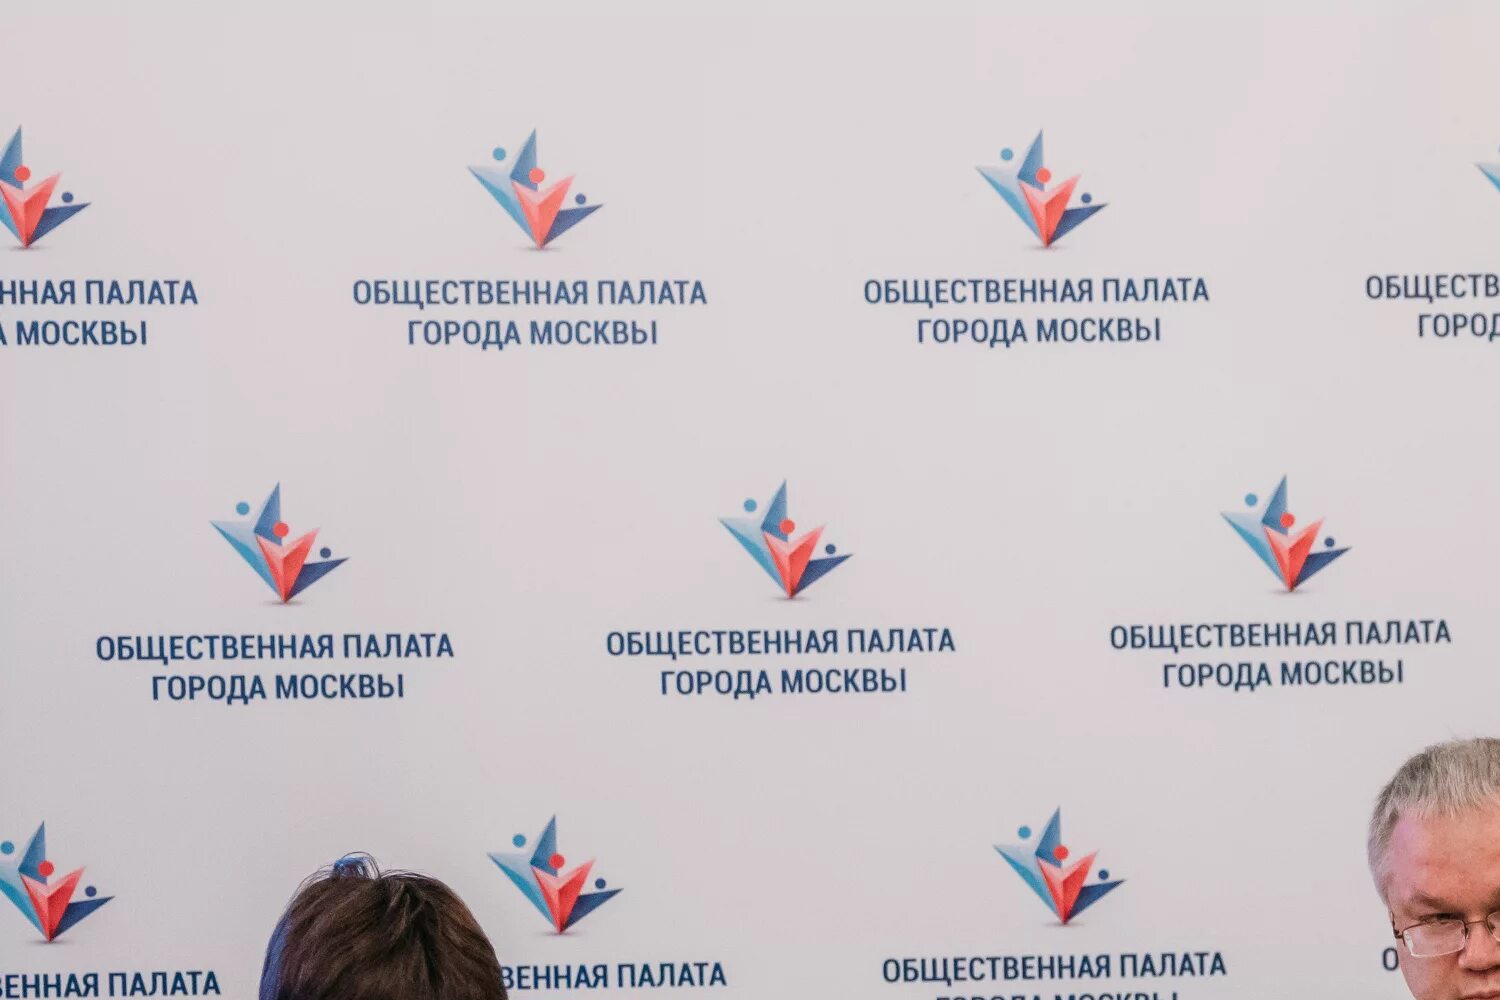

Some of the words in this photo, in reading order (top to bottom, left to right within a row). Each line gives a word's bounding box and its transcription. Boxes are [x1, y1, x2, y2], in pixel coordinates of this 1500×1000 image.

[85, 279, 198, 305] ПАЛАТА
[353, 279, 588, 311] ОБЩЕСТВЕННАЯ
[597, 280, 708, 305] ПАЛАТА
[864, 278, 1093, 309] ОБЩЕСТВЕННАЯ
[1102, 277, 1210, 303] ПАЛАТА
[16, 320, 147, 346] МОСКВЫ
[408, 320, 522, 351] ГОРОДА
[530, 320, 657, 345] МОСКВЫ
[918, 318, 1028, 349] ГОРОДА
[1036, 317, 1161, 343] МОСКВЫ
[96, 634, 334, 666] ОБЩЕСТВЕННАЯ
[343, 633, 454, 659] ПАЛАТА
[606, 629, 838, 661] ОБЩЕСТВЕННАЯ
[847, 628, 956, 653] ПАЛАТА
[1110, 621, 1337, 654] ОБЩЕСТВЕННАЯ
[1345, 619, 1452, 645] ПАЛАТА
[152, 674, 267, 706] ГОРОДА
[275, 673, 404, 700] МОСКВЫ
[661, 669, 772, 700] ГОРОДА
[781, 668, 906, 694] МОСКВЫ
[1163, 662, 1273, 692] ГОРОДА
[1280, 659, 1403, 686] МОСКВЫ
[108, 970, 221, 997] ПАЛАТА
[617, 962, 727, 988] ПАЛАТА
[882, 954, 1111, 987] ОБЩЕСТВЕННАЯ
[1119, 952, 1227, 978] ПАЛАТА
